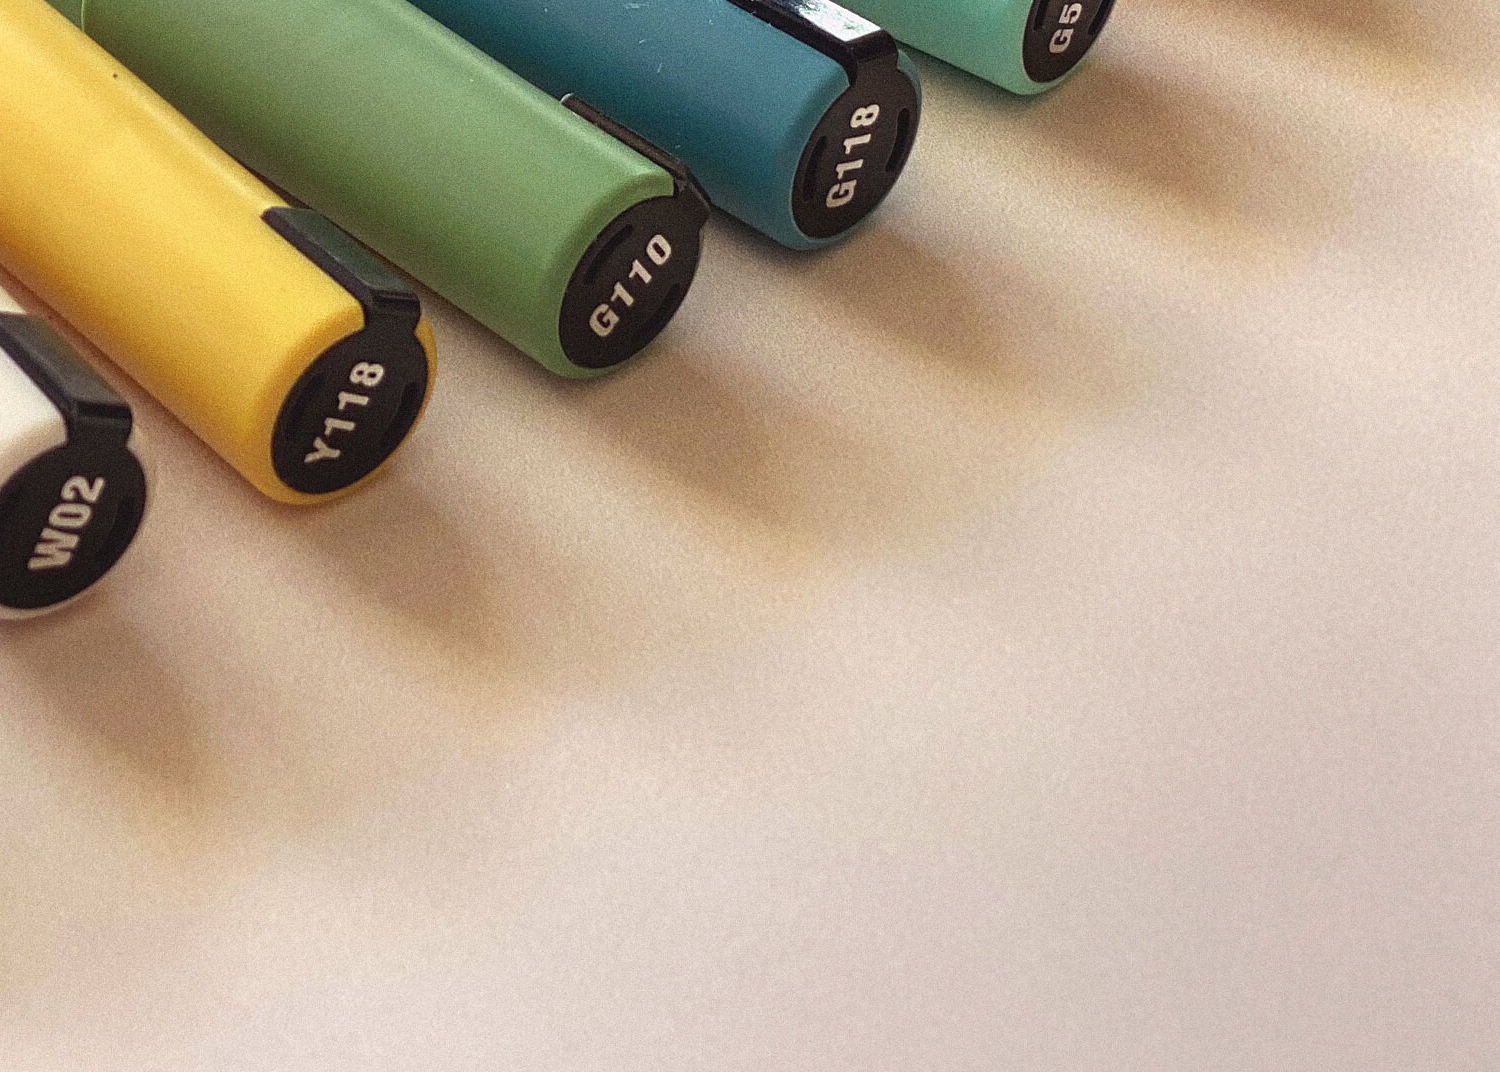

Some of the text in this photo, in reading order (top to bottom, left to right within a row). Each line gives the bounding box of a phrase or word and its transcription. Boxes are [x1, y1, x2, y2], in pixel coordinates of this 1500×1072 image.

[826, 103, 880, 208] G118
[589, 234, 672, 337] G110
[304, 361, 385, 463] Y118
[27, 475, 105, 570] W02
